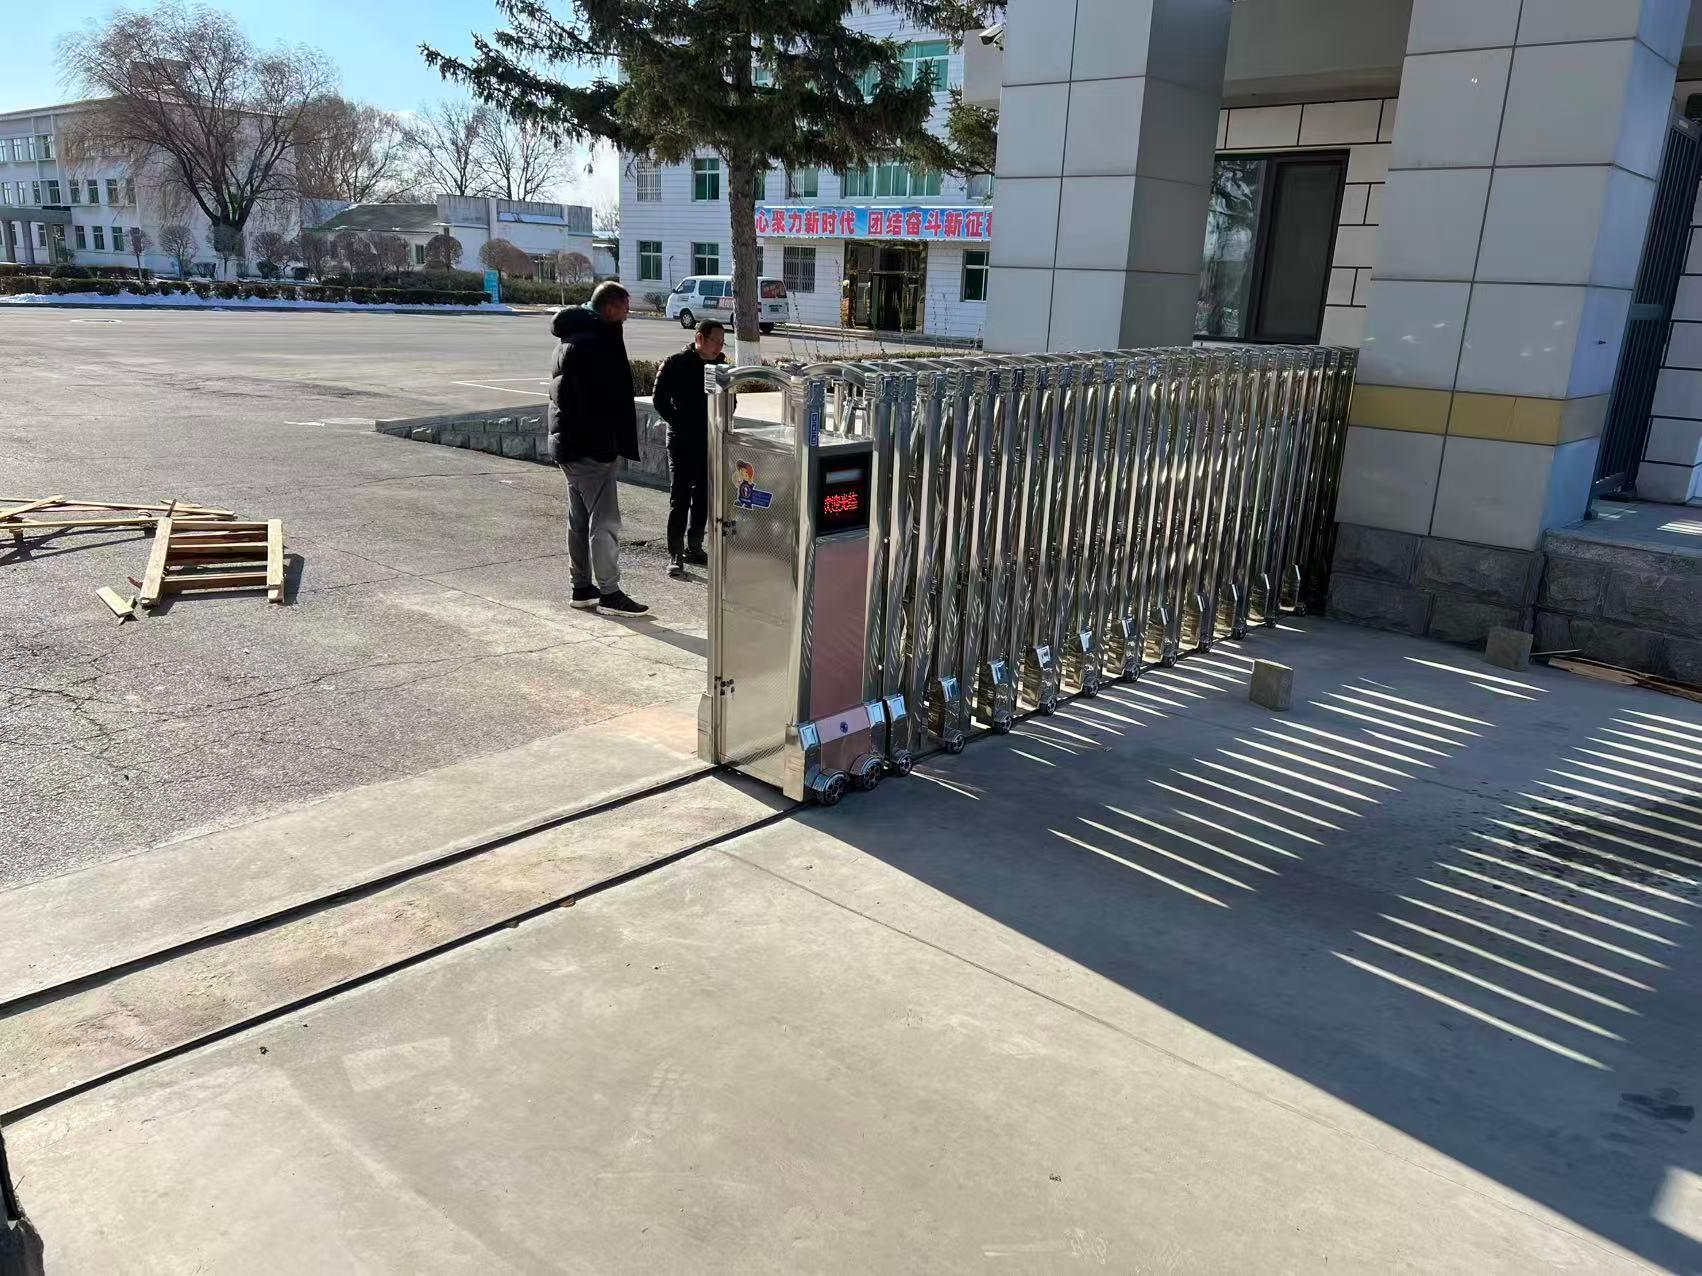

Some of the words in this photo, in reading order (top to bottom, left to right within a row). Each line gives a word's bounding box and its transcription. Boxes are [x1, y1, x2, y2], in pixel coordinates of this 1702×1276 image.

[755, 209, 855, 235] 心聚力新时代
